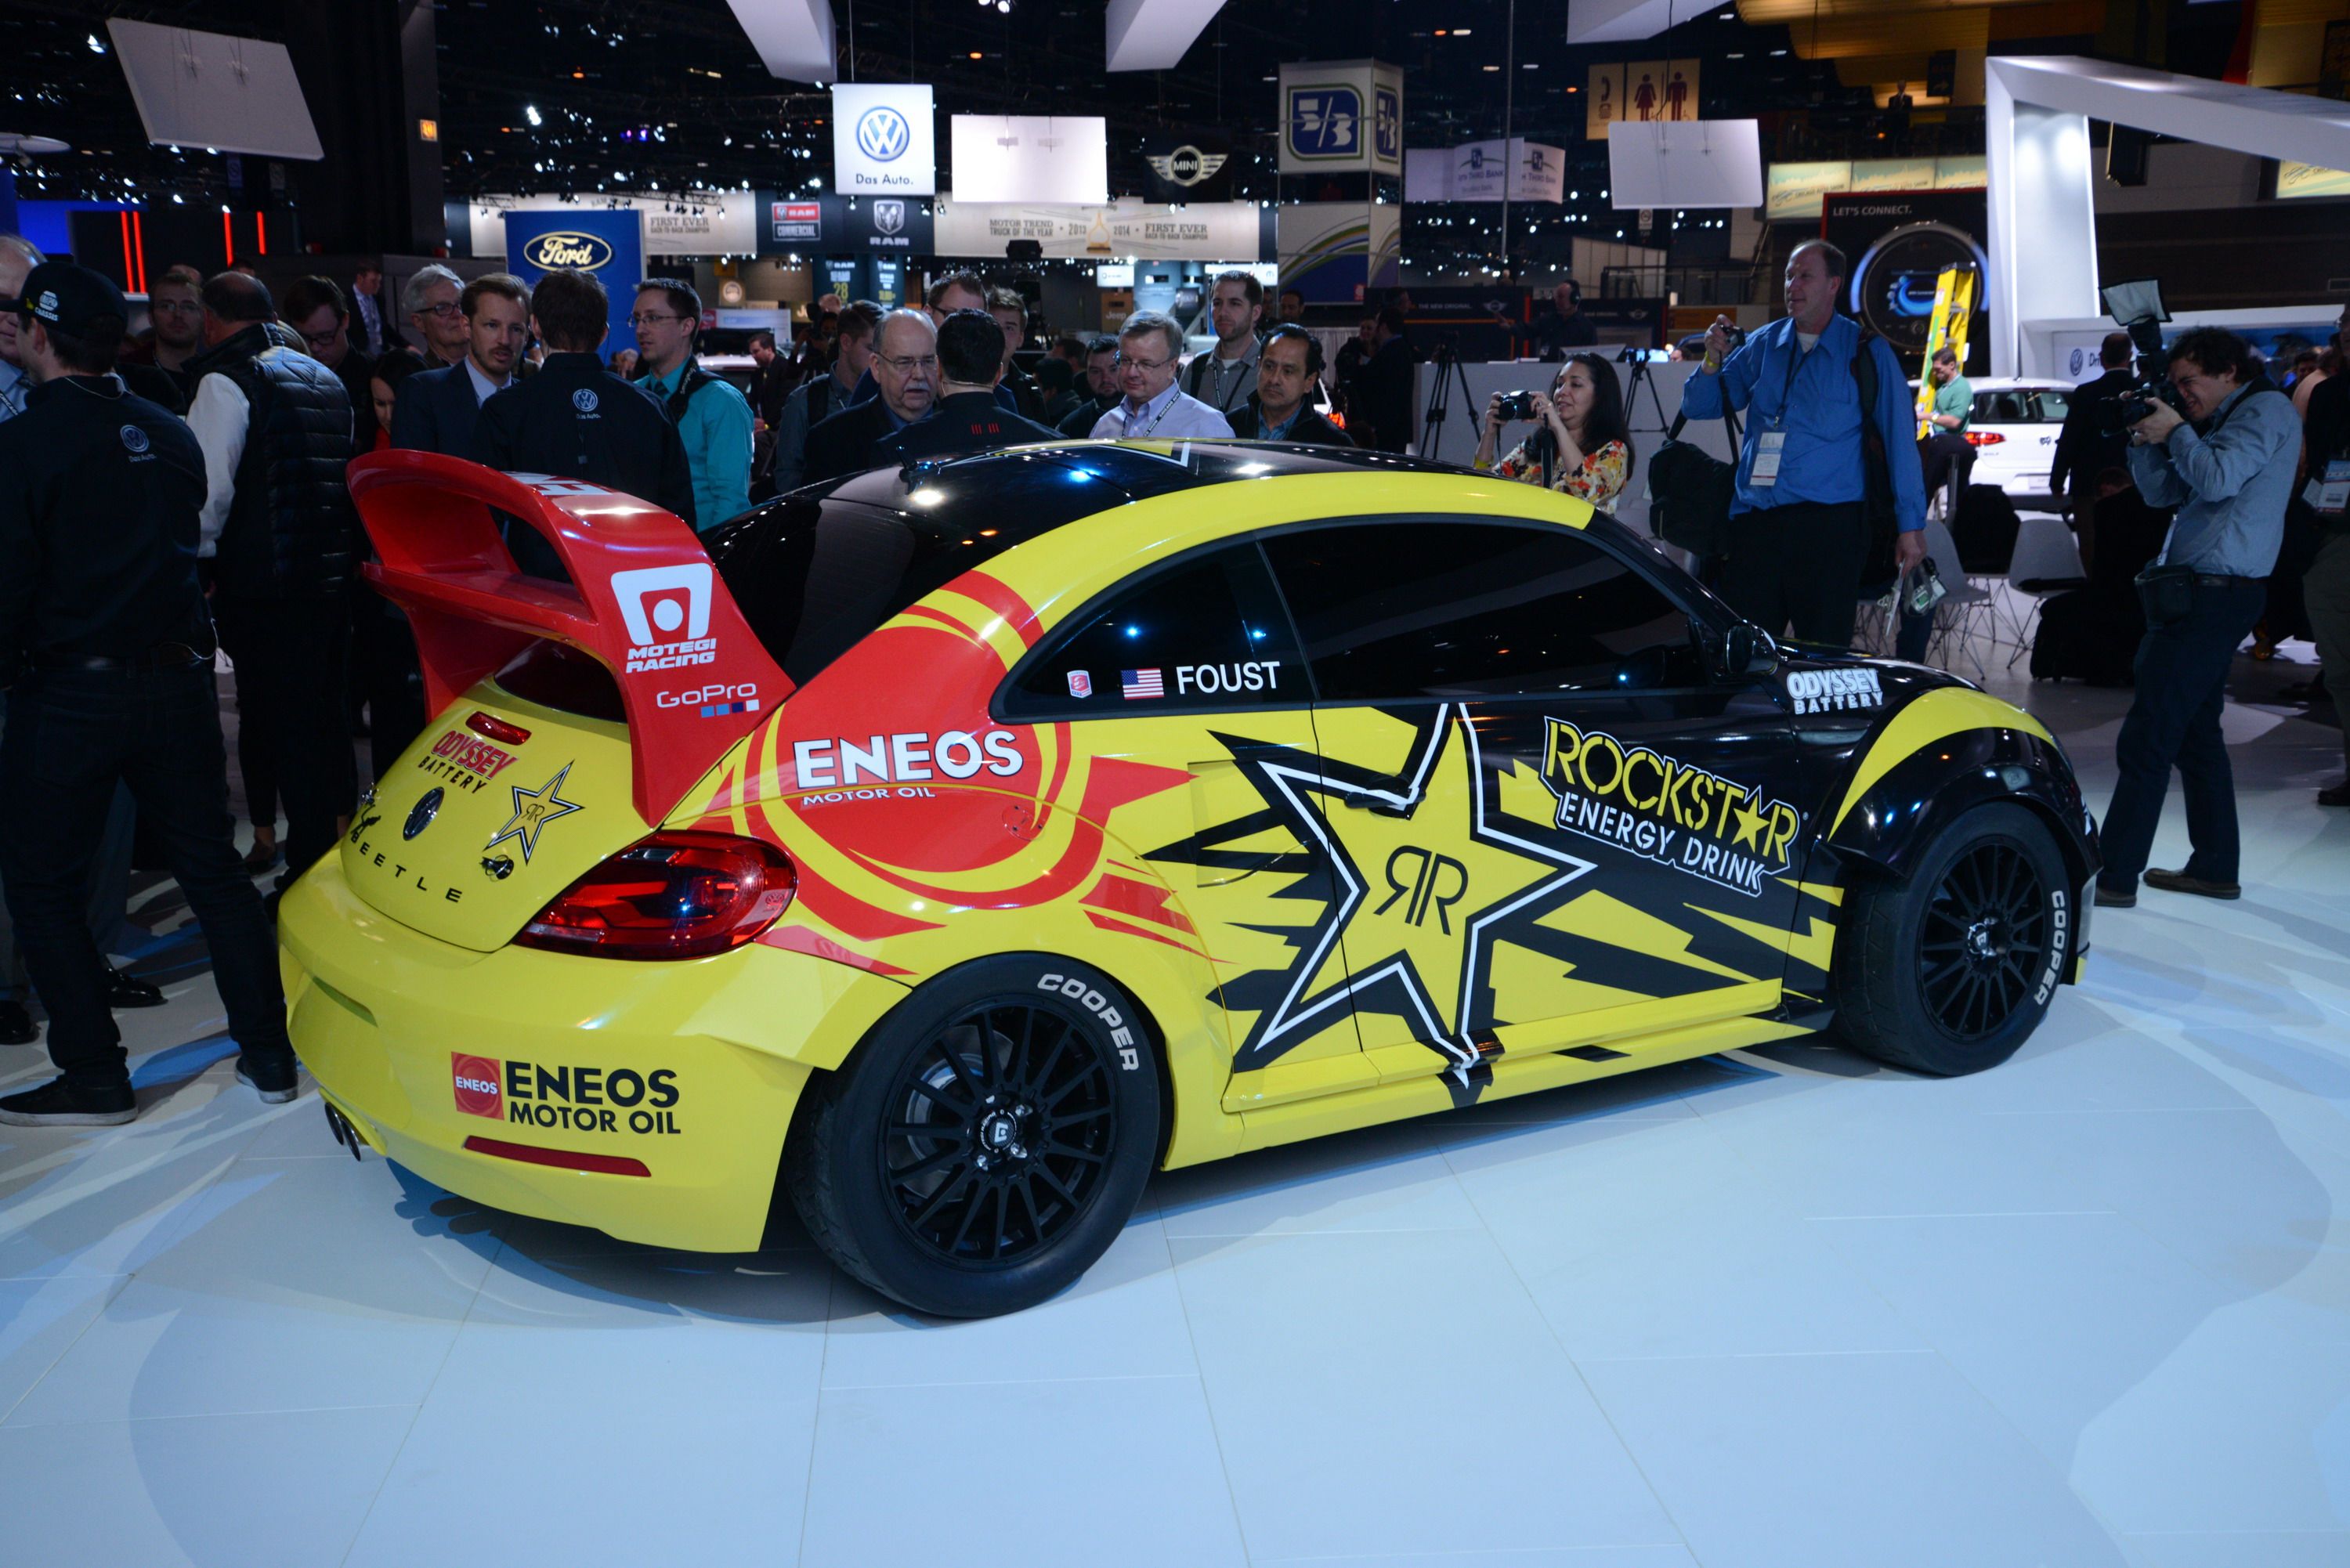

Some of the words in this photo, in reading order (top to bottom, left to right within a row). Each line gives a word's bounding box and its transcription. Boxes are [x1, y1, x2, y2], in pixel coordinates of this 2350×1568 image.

[1173, 161, 1198, 171] MINI
[855, 174, 877, 185] Das
[882, 174, 913, 185] Auto.
[650, 217, 678, 226] FIRST
[682, 217, 709, 226] EVER
[1862, 205, 1912, 216] CONNECT.
[777, 225, 816, 237] COMMERCIAL
[990, 227, 1010, 236] TRUCK
[1023, 219, 1054, 228] TREND
[1068, 223, 1087, 235] 2013
[1114, 225, 1130, 235] 2014
[1145, 223, 1176, 233] FIRST
[1180, 223, 1207, 233] EVER
[539, 236, 593, 266] Ford
[870, 237, 909, 246] RAM
[627, 638, 717, 660] MOTEGI
[626, 652, 716, 674] RACING
[1176, 661, 1281, 695] FOUST
[1787, 668, 1882, 699] ODYSSEY
[656, 683, 757, 708] GoPro
[1794, 691, 1883, 714] BATTERY
[431, 730, 519, 780] ODYSSEY
[793, 730, 1024, 789] ENEOS
[418, 756, 487, 793] BATTERY
[803, 789, 891, 806] MOTOR
[898, 787, 936, 798] OIL
[1560, 791, 1676, 855] ENERGY
[1683, 836, 1766, 891] DRINK
[350, 831, 463, 903] BEETLE
[2034, 890, 2066, 1006] COOPER
[1037, 974, 1139, 1071] COOPER
[455, 1076, 498, 1095] ENEOS
[505, 1060, 680, 1108] ENEOS
[510, 1101, 618, 1133] MOTOR
[629, 1110, 682, 1135] OIL
